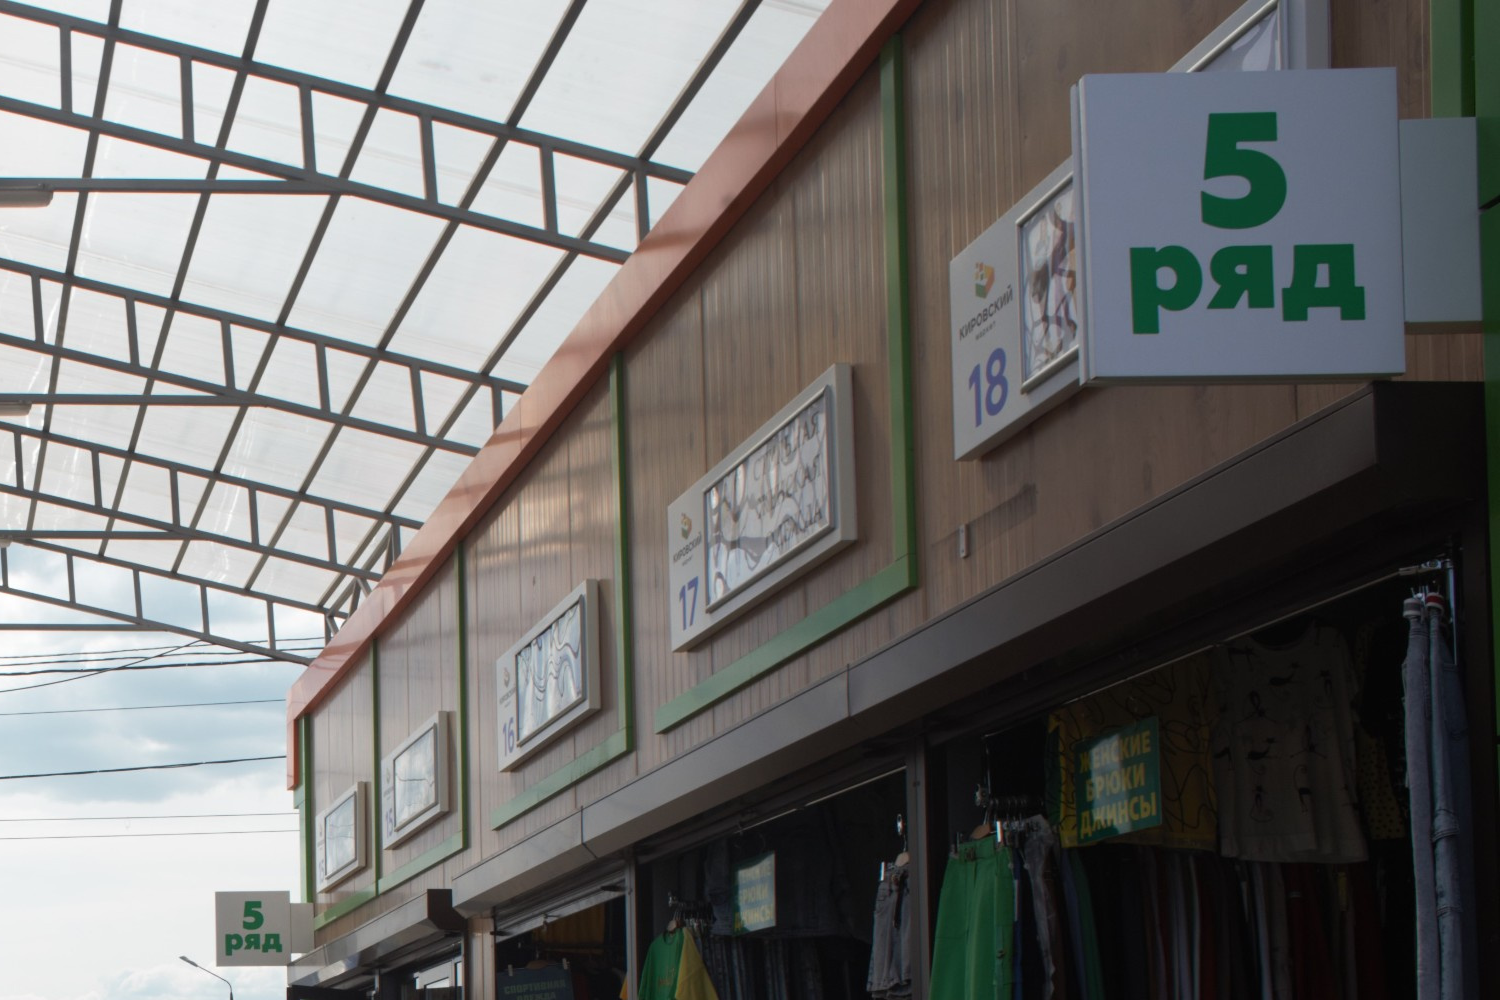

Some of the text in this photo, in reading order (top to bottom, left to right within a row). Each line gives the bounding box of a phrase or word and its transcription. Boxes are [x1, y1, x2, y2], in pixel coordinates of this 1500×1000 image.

[1201, 112, 1287, 229] 5
[1130, 244, 1365, 334] ряд
[959, 284, 1014, 341] КИРОВСКИЙ
[968, 347, 1008, 428] 18
[679, 576, 699, 631] 17
[502, 717, 514, 757] 16
[1079, 730, 1151, 774] ЖЕНСКИЕ
[1086, 762, 1146, 803] БРЮКИ
[1080, 791, 1157, 840] ДЖИНСЫ
[243, 900, 264, 930] 5
[225, 933, 283, 956] ряд
[503, 979, 566, 995] СПОРТИВНАЯ
